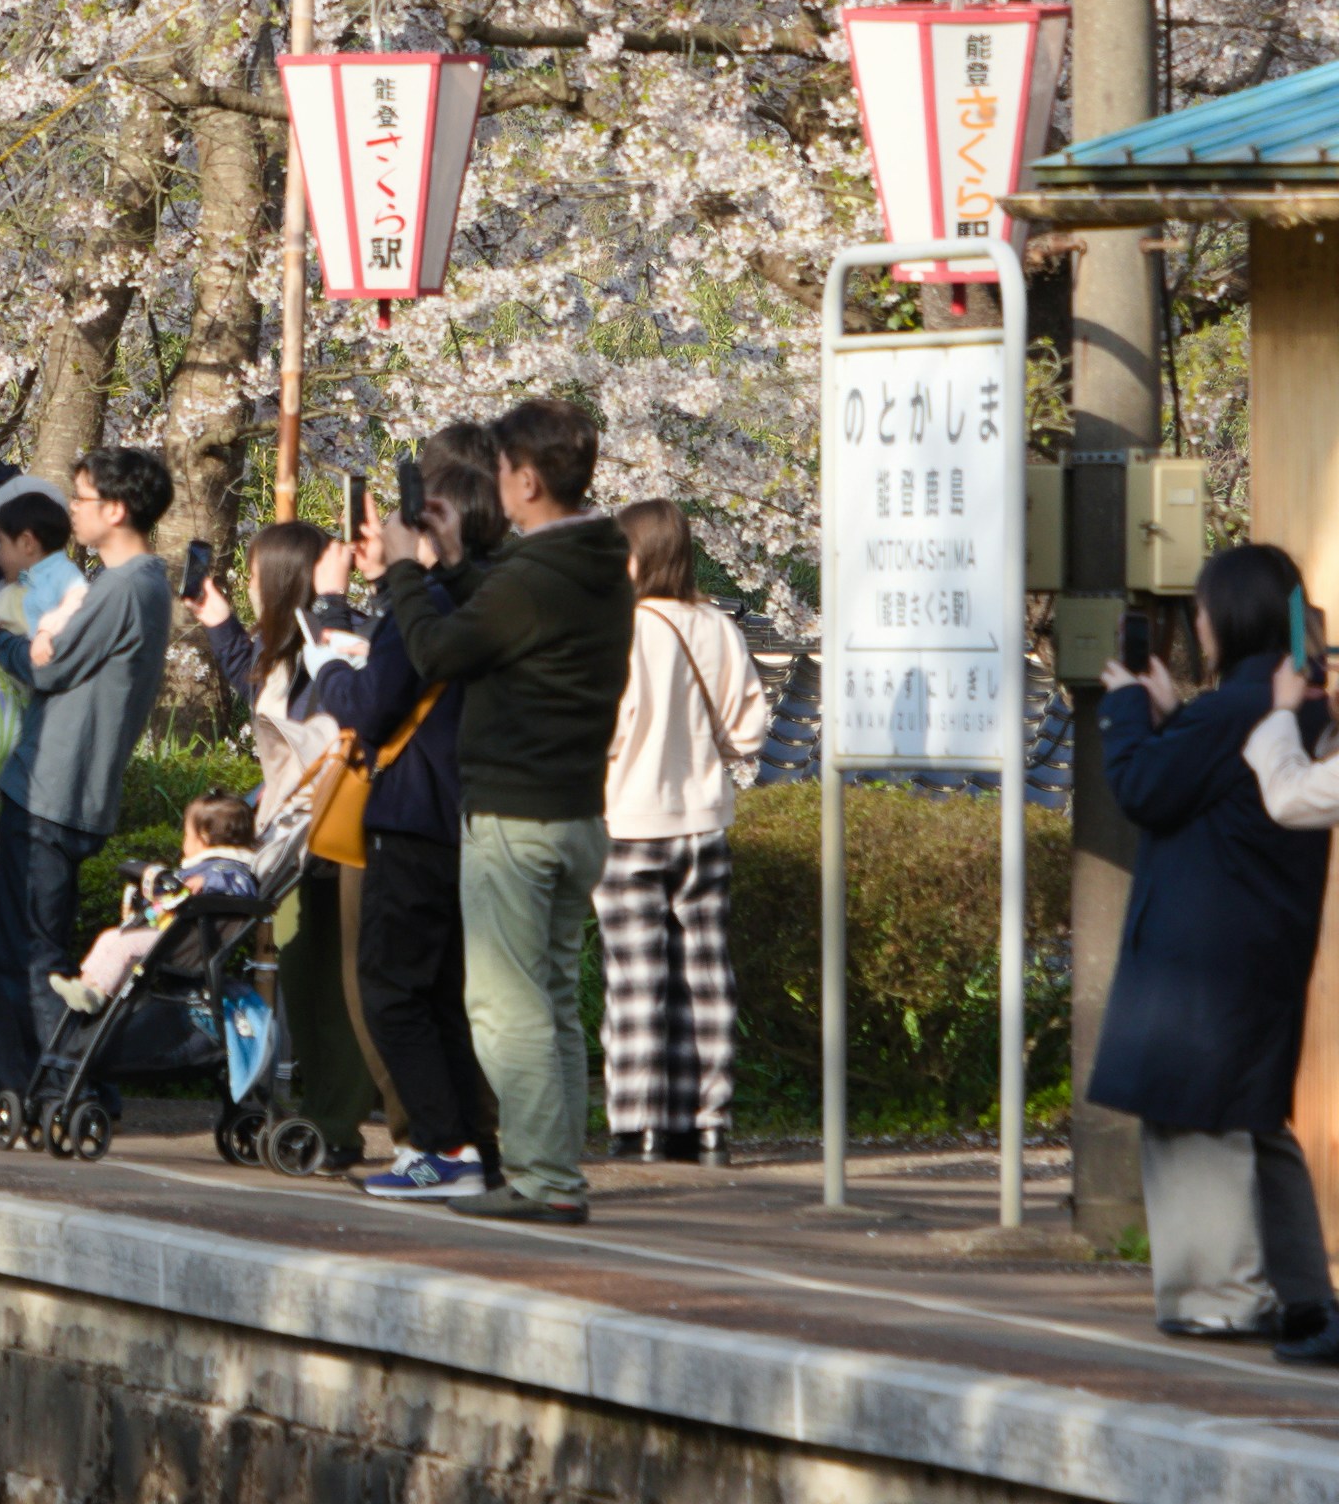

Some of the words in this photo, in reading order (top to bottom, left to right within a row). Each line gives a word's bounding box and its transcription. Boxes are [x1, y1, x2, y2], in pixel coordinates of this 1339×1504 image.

[366, 77, 407, 270] 能登さくら駅
[844, 377, 999, 445] のとかしま
[877, 468, 965, 518] 能登鹿島
[866, 539, 977, 571] NOTOKASHIMA
